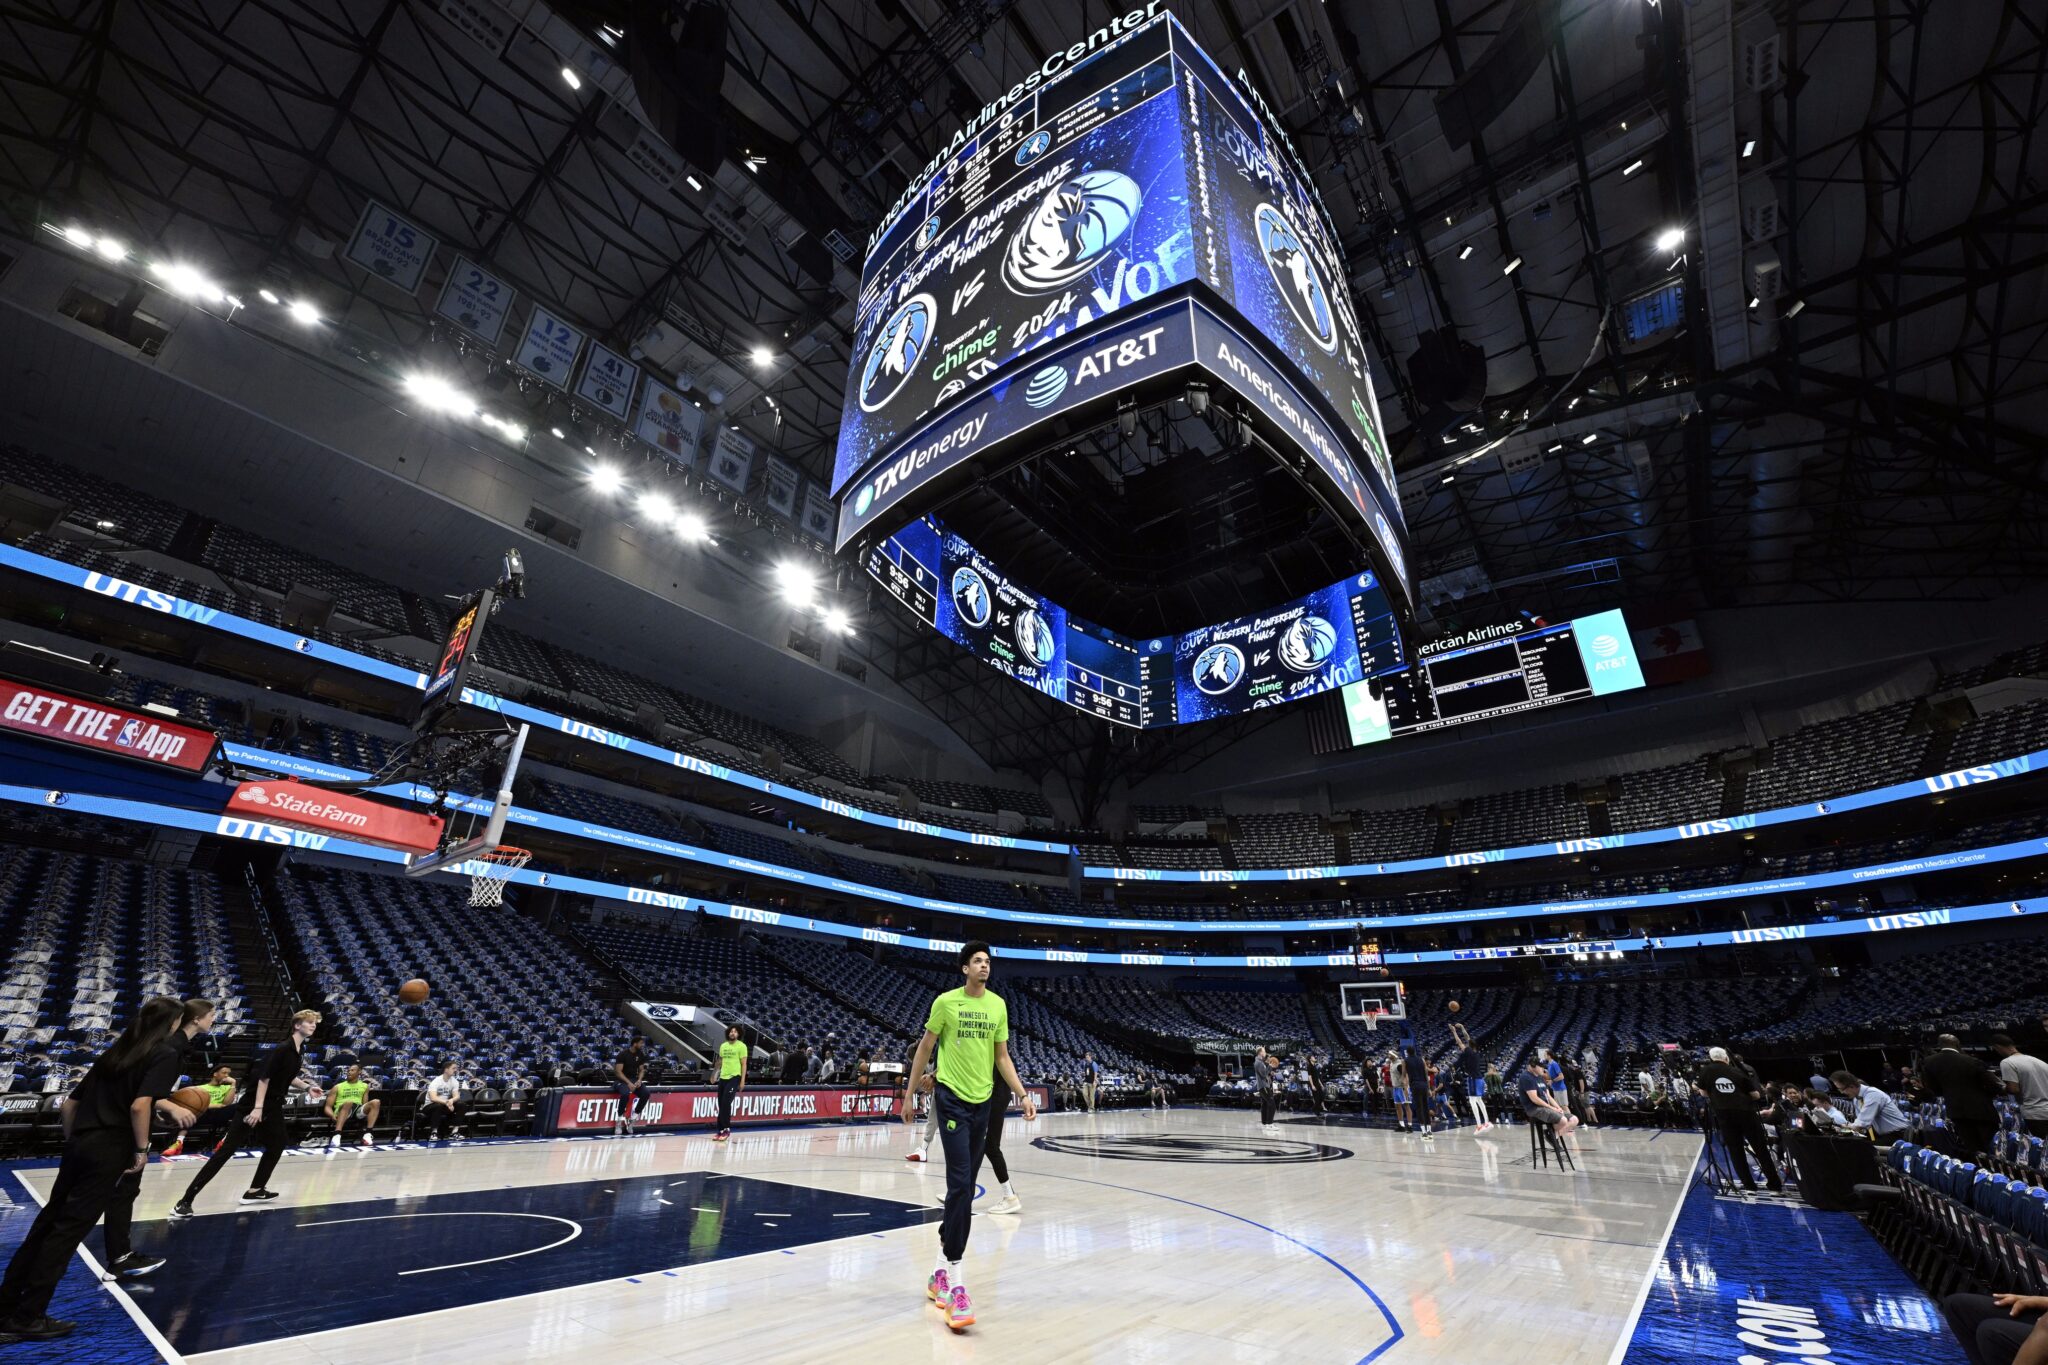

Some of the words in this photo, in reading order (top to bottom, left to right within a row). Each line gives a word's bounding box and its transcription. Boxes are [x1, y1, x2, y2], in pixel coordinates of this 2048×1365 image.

[1057, 110, 1076, 125] FIELD
[1076, 97, 1100, 114] GOALS
[1000, 113, 1013, 129] 0
[1057, 129, 1075, 144] FREE
[1075, 112, 1106, 132] THROWS
[999, 129, 1013, 142] TOL
[947, 159, 959, 174] 0
[965, 147, 991, 172] 9:56
[383, 217, 417, 249] 15
[898, 235, 960, 303] WESTERN
[965, 158, 1075, 243] CONFERENCE
[364, 228, 391, 251] BRAD
[391, 245, 421, 266] DAVIS
[370, 242, 410, 268] 1980-92
[950, 221, 1004, 274] FINALS
[466, 270, 500, 302] 22
[952, 269, 986, 316] VS
[457, 295, 493, 321] 1981-92
[1012, 291, 1078, 348] 2024
[543, 317, 571, 346] 12
[932, 327, 1001, 381] chime
[1074, 326, 1164, 386] AT&T
[602, 357, 625, 378] 41
[1217, 342, 1302, 430] American
[1302, 418, 1350, 483] Airlines
[645, 412, 694, 446] CHAMPIONS
[889, 565, 909, 589] 9:56
[916, 567, 923, 581] 0
[84, 571, 220, 624] UTSW
[996, 586, 1017, 607] FINALS
[1001, 578, 1038, 609] CONFERENCE
[996, 610, 1010, 626] VS
[1213, 624, 1251, 642] WESTERN
[1254, 606, 1305, 631] CONFERENCE
[1355, 617, 1365, 625] STL
[1248, 628, 1276, 644] FINALS
[1419, 636, 1465, 656] erican
[1467, 620, 1523, 644] Airlines
[989, 641, 1015, 662] chime
[1253, 649, 1271, 667] VS
[1428, 654, 1450, 663] DALLAS
[1520, 646, 1548, 656] REBOUNDS
[1522, 654, 1541, 663] STEALS
[1018, 665, 1038, 678] 2024
[1524, 661, 1544, 669] BLOCKS
[1594, 655, 1628, 673] AT&T
[1080, 671, 1088, 683] 0
[1290, 674, 1317, 695] 2024
[1528, 676, 1546, 684] POINTS
[1530, 682, 1548, 690] POINTS
[1118, 686, 1125, 697] 0
[1248, 681, 1283, 697] chime
[1436, 683, 1469, 695] MINNESOTA
[1092, 693, 1113, 708] 9:56
[4, 691, 68, 728] GET
[64, 704, 121, 742] THE
[136, 724, 187, 762] App
[1429, 721, 1444, 729] YOUR
[1463, 714, 1480, 722] GEAR
[561, 718, 631, 750] UTSW
[241, 752, 270, 764] Partner
[279, 760, 292, 768] the
[292, 762, 315, 773] Dallas
[315, 768, 351, 781] Mavericks
[674, 752, 731, 780] UTSW
[1926, 756, 2030, 794] UTSW
[515, 812, 539, 823] Center
[821, 798, 863, 821] UTSW
[216, 816, 330, 851] UTSW
[898, 818, 941, 837] UTSW
[1678, 814, 1756, 839] UTSW
[971, 833, 1016, 848] UTSW
[1556, 835, 1625, 855] UTSW
[1445, 850, 1505, 867] UTSW
[1924, 856, 1957, 869] Medical
[1958, 852, 1986, 866] Center
[1114, 868, 1162, 880] UTSW
[1200, 870, 1250, 882] UTSW
[1287, 866, 1340, 880] UTSW
[627, 887, 689, 910] UTSW
[1618, 898, 1638, 906] Center
[730, 905, 781, 924] UTSW
[1867, 909, 1950, 932] UTSW
[863, 928, 901, 944] UTSW
[1732, 925, 1806, 944] UTSW
[1046, 950, 1088, 962] UTSW
[1121, 953, 1164, 965] UTSW
[1247, 956, 1292, 967] UTSW
[652, 1007, 675, 1017] Ford
[958, 1011, 988, 1020] MINNESOTA
[957, 1029, 990, 1039] BASKETBALL
[1196, 1042, 1229, 1052] shiftkey
[1718, 1082, 1735, 1090] TNT
[4, 1099, 39, 1109] PLAYOFFS
[577, 1098, 604, 1123] GET
[604, 1098, 619, 1122] TH
[641, 1100, 664, 1124] App
[692, 1095, 741, 1119] NONSOP
[742, 1095, 780, 1116] PLAYOFF
[782, 1094, 817, 1115] ACCESS.
[841, 1094, 855, 1113] GET
